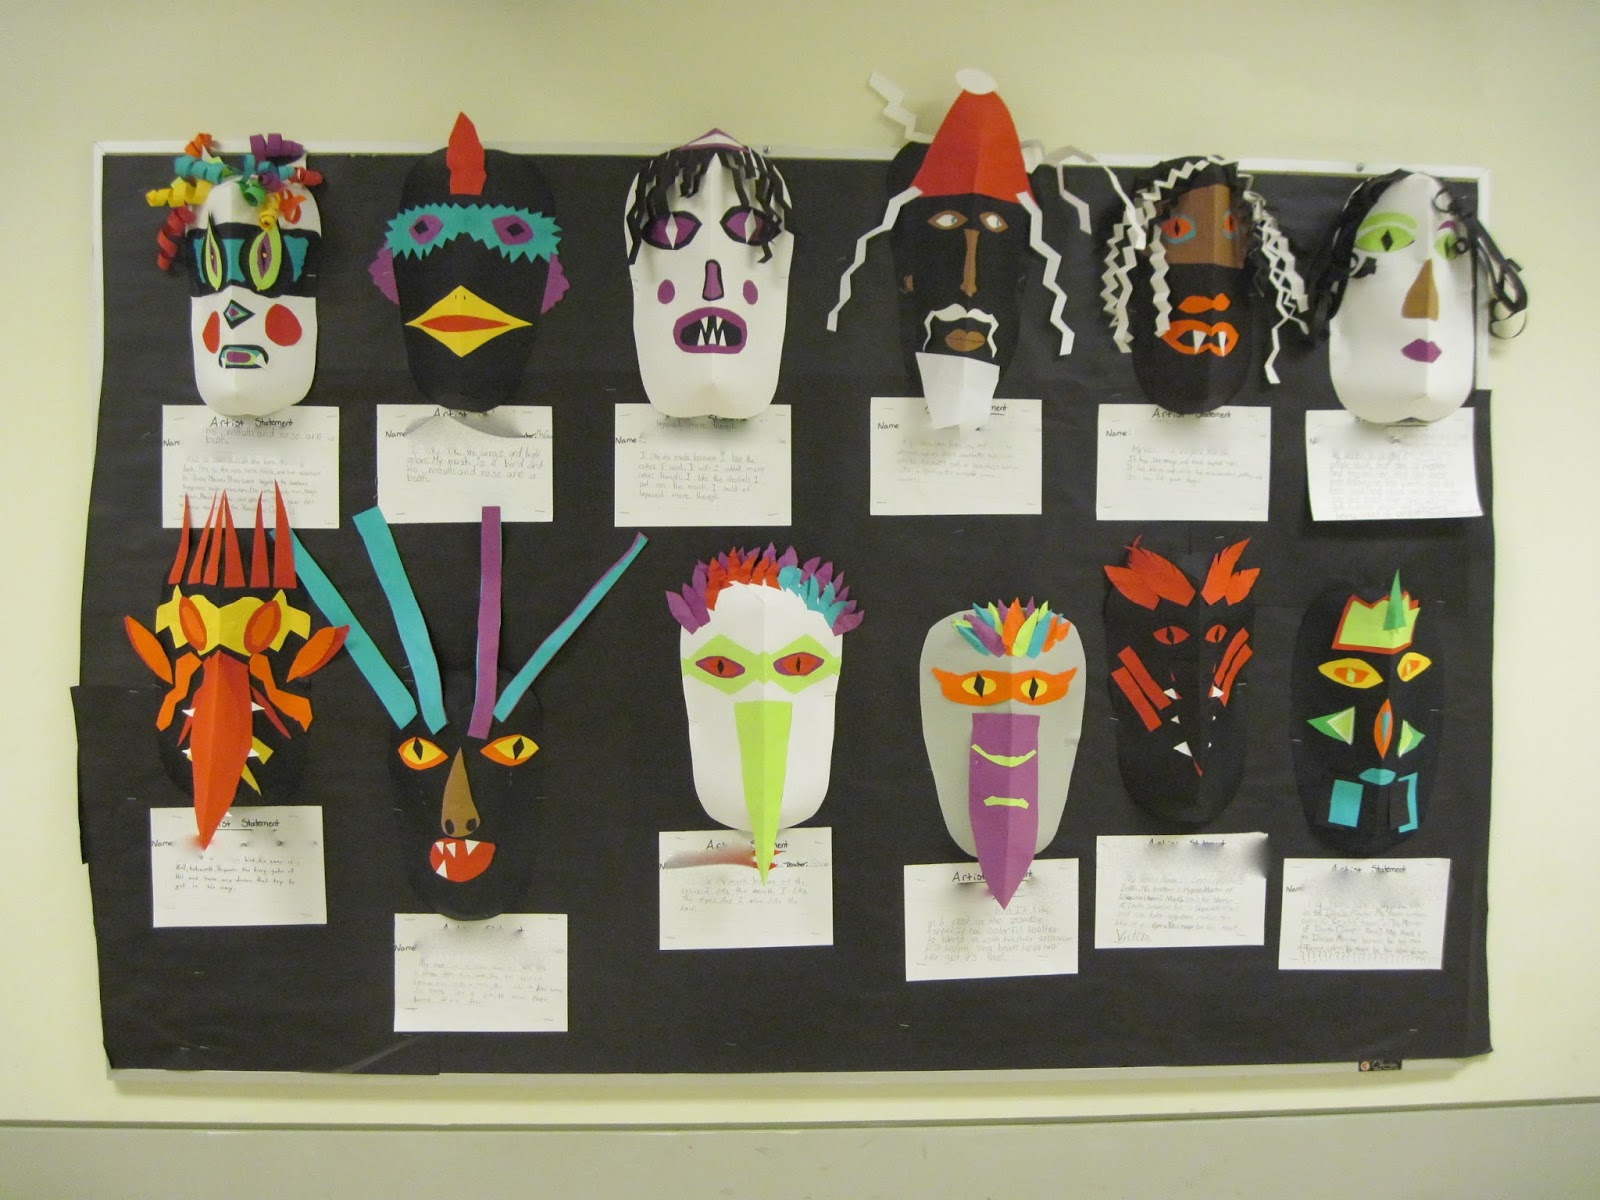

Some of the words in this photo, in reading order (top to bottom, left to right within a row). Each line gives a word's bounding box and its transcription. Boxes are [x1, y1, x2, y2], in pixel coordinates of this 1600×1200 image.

[433, 408, 468, 418] Artist
[210, 416, 244, 427] Artist
[254, 418, 294, 427] Statement
[241, 819, 280, 828] Statement
